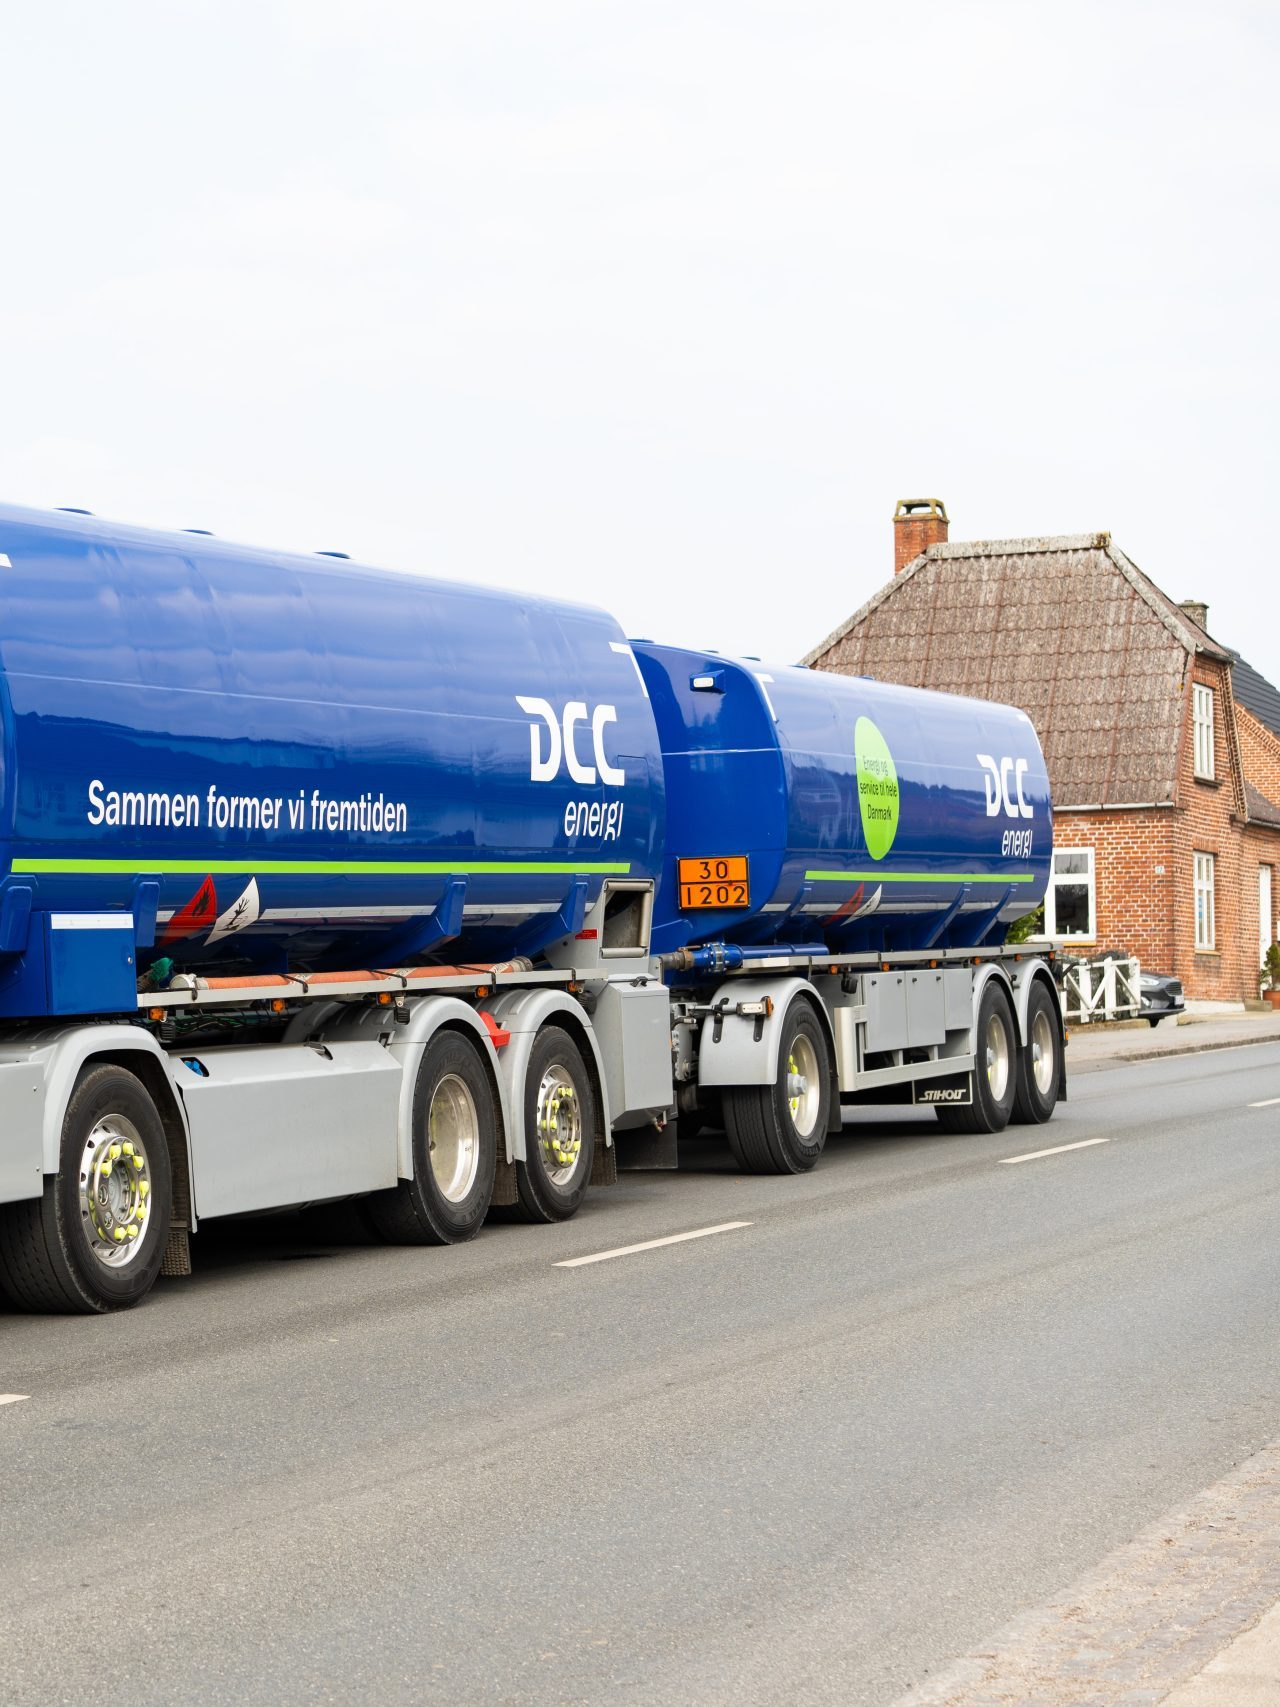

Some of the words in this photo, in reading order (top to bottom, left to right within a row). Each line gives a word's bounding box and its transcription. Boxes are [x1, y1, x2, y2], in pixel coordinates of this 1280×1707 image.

[515, 695, 625, 786] DCC
[859, 780, 879, 796] service
[976, 753, 1034, 818] DCC
[87, 779, 199, 827] Sammen
[206, 784, 283, 829] former
[288, 789, 305, 829] vi
[311, 789, 407, 832] fremtiden
[867, 803, 892, 820] Danmark
[699, 861, 729, 879] 30
[687, 885, 746, 905] 1202
[918, 1089, 967, 1101] STIHOLT
